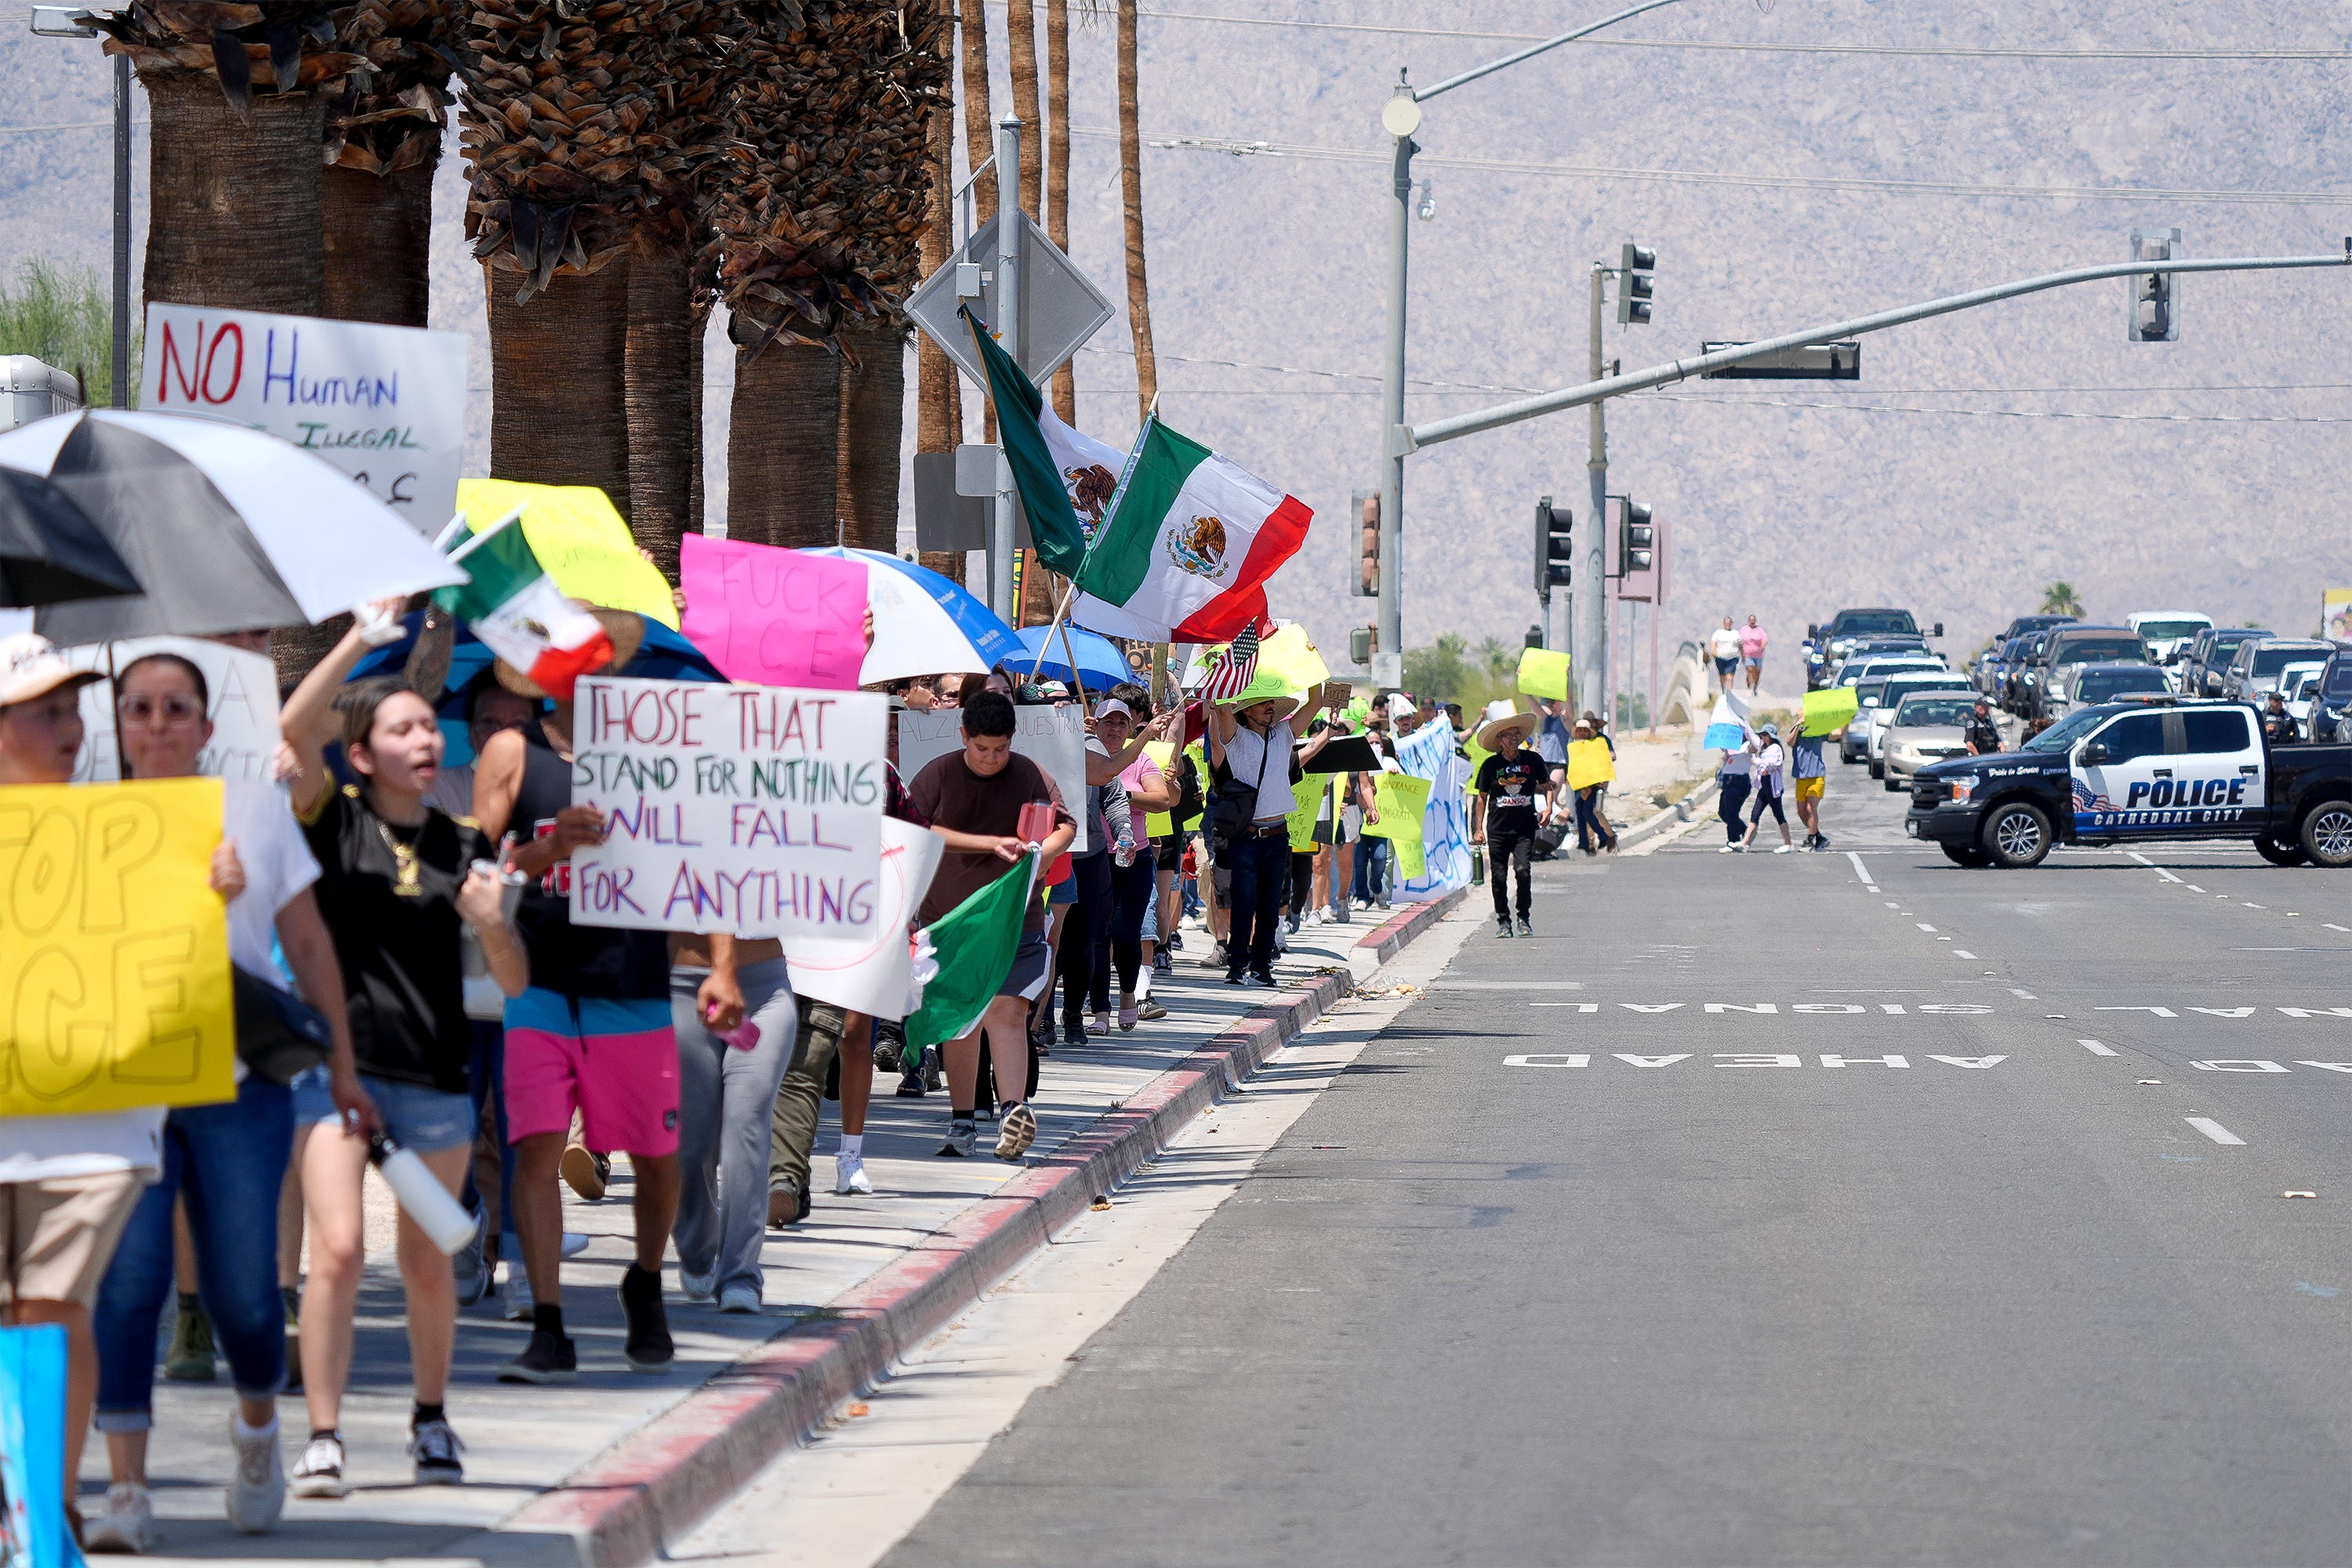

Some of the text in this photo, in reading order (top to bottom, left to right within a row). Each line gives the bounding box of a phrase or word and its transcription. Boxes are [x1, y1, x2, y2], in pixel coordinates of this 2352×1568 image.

[158, 318, 244, 405] NO
[716, 551, 851, 627] FUCK
[724, 612, 838, 679] ICE
[590, 685, 836, 753] THOSE THAT
[573, 751, 878, 806] STAND FOR NOTHING
[2126, 778, 2247, 808] POLICE
[590, 795, 853, 852] WILL FALL
[2094, 808, 2245, 826] CATHEDRAL CITY
[579, 860, 874, 928] FOR ANYTHING
[1529, 1003, 1994, 1014] SIGNAL
[1502, 1053, 2009, 1069] AHEAD
